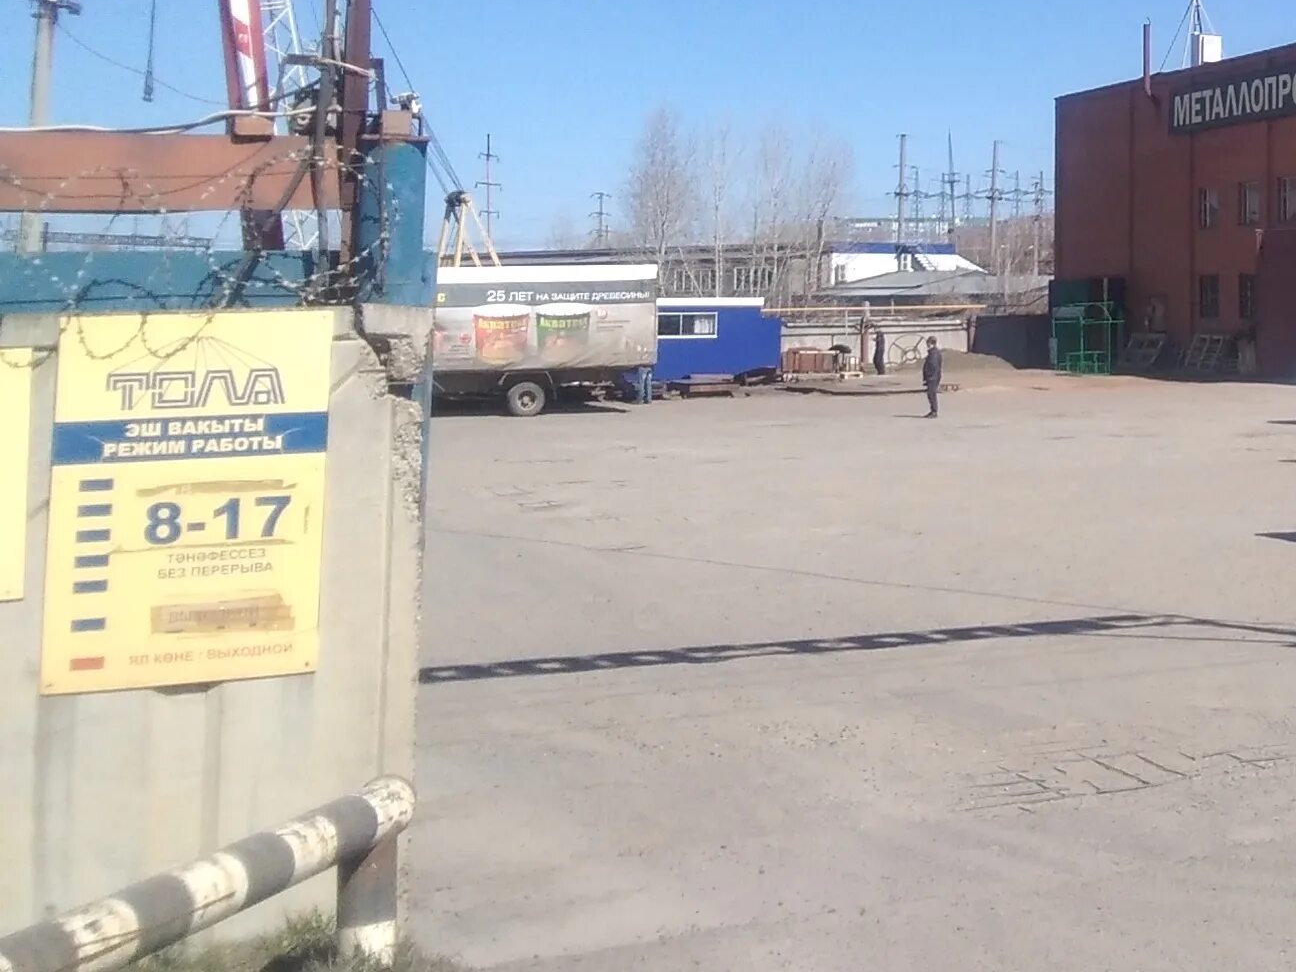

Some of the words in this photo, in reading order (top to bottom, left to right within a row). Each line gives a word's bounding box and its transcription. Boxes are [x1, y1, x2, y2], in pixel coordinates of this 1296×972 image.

[486, 290, 506, 302] 25
[508, 291, 534, 302] ЛЕТ
[536, 293, 550, 302] НА
[551, 291, 590, 302] ЗАЩИТЕ
[105, 367, 286, 411] ТОЛА
[124, 421, 162, 437] ЭШ
[167, 417, 264, 436] ВАКЫТЫ
[102, 439, 186, 458] РЕЖИМ
[190, 434, 283, 453] РАБОТЫ
[143, 494, 292, 545] 8-17
[157, 567, 187, 579] БЕЗ
[190, 561, 274, 578] ПЕРЕРЫВА
